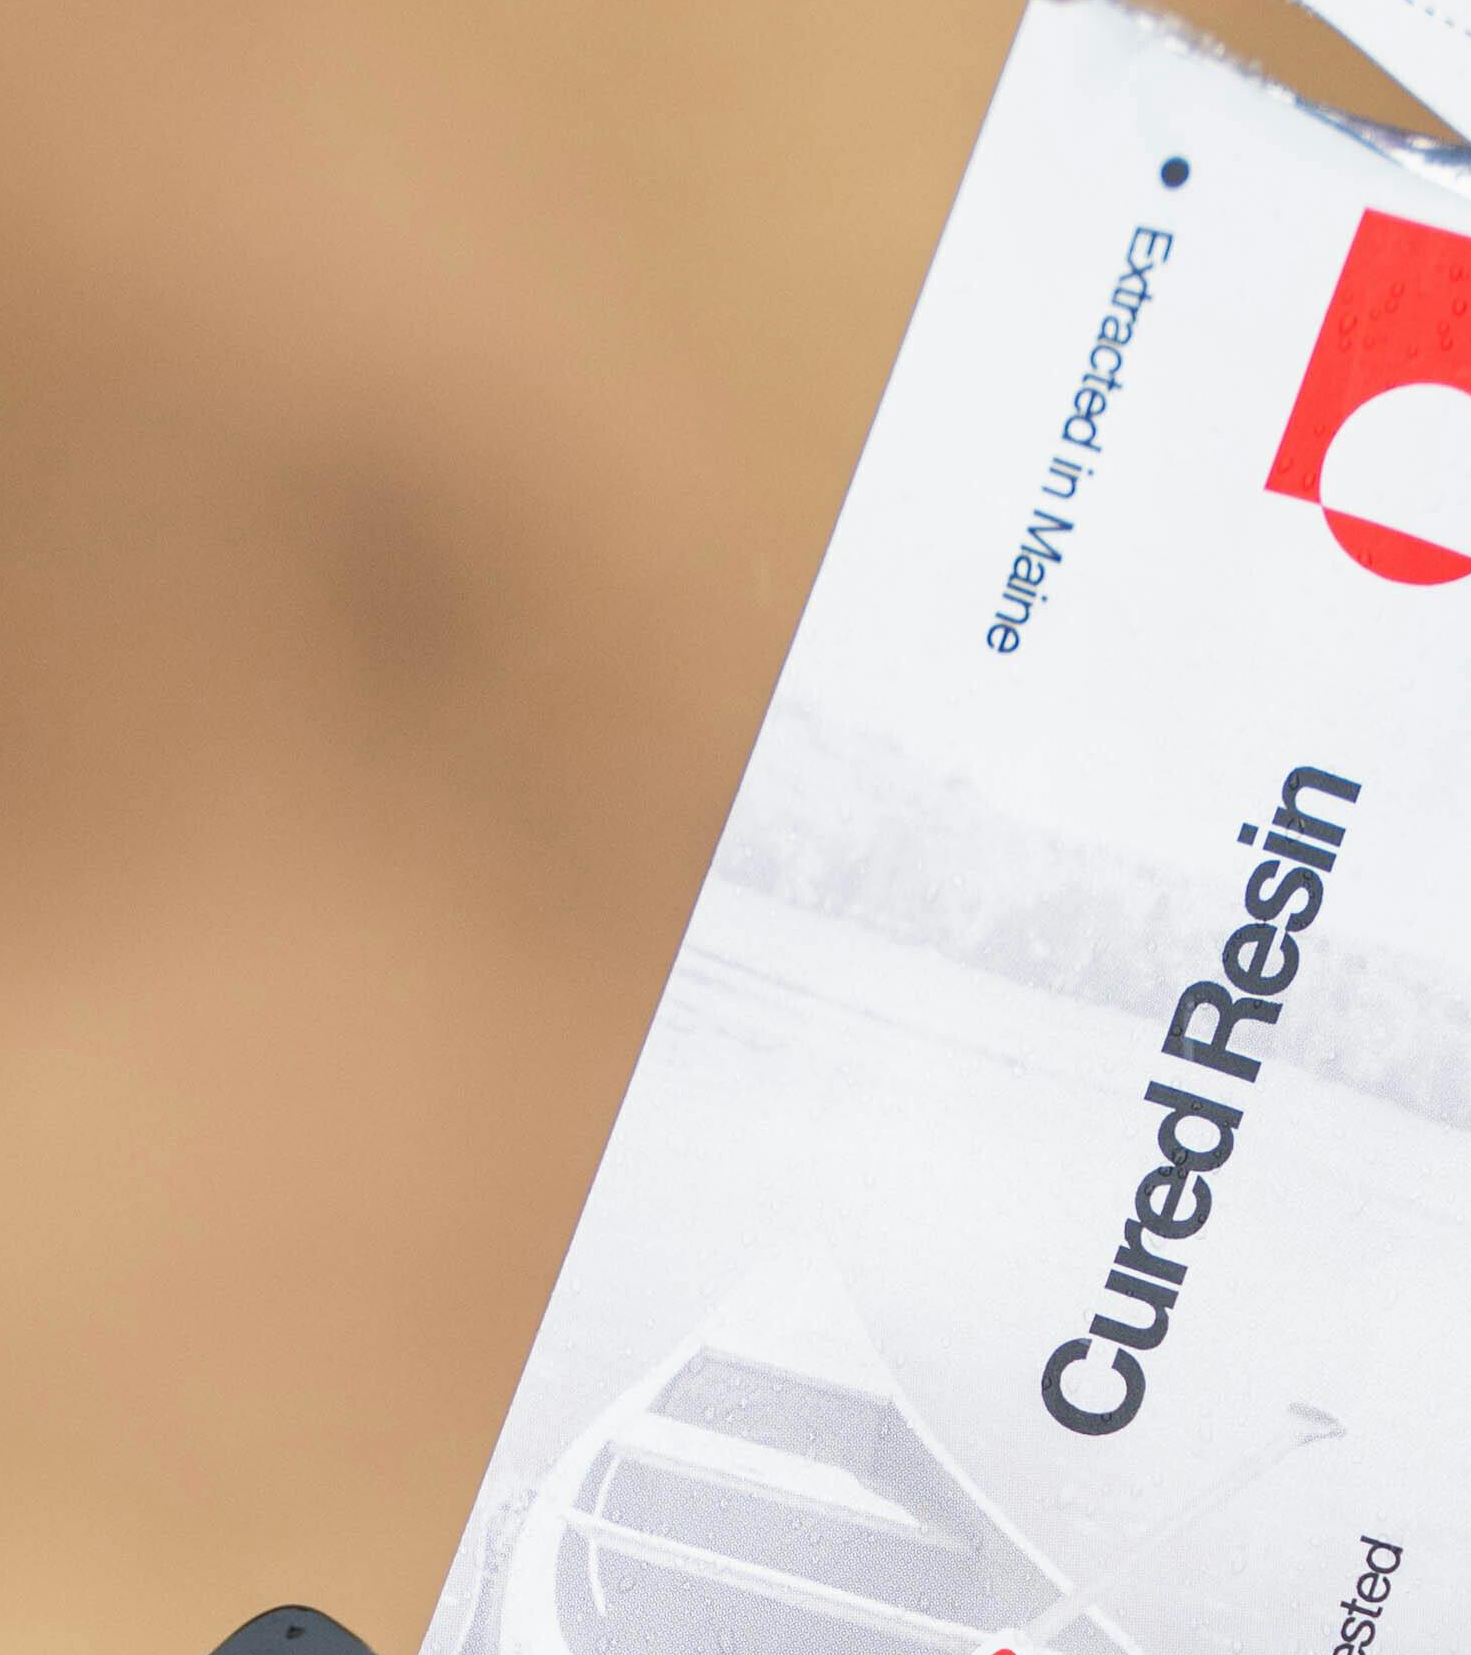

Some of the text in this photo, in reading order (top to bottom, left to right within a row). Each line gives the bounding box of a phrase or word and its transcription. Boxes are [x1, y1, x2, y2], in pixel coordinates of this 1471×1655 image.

[985, 225, 1175, 656] Extracted in Maine
[1040, 764, 1363, 1437] Cured Resin
